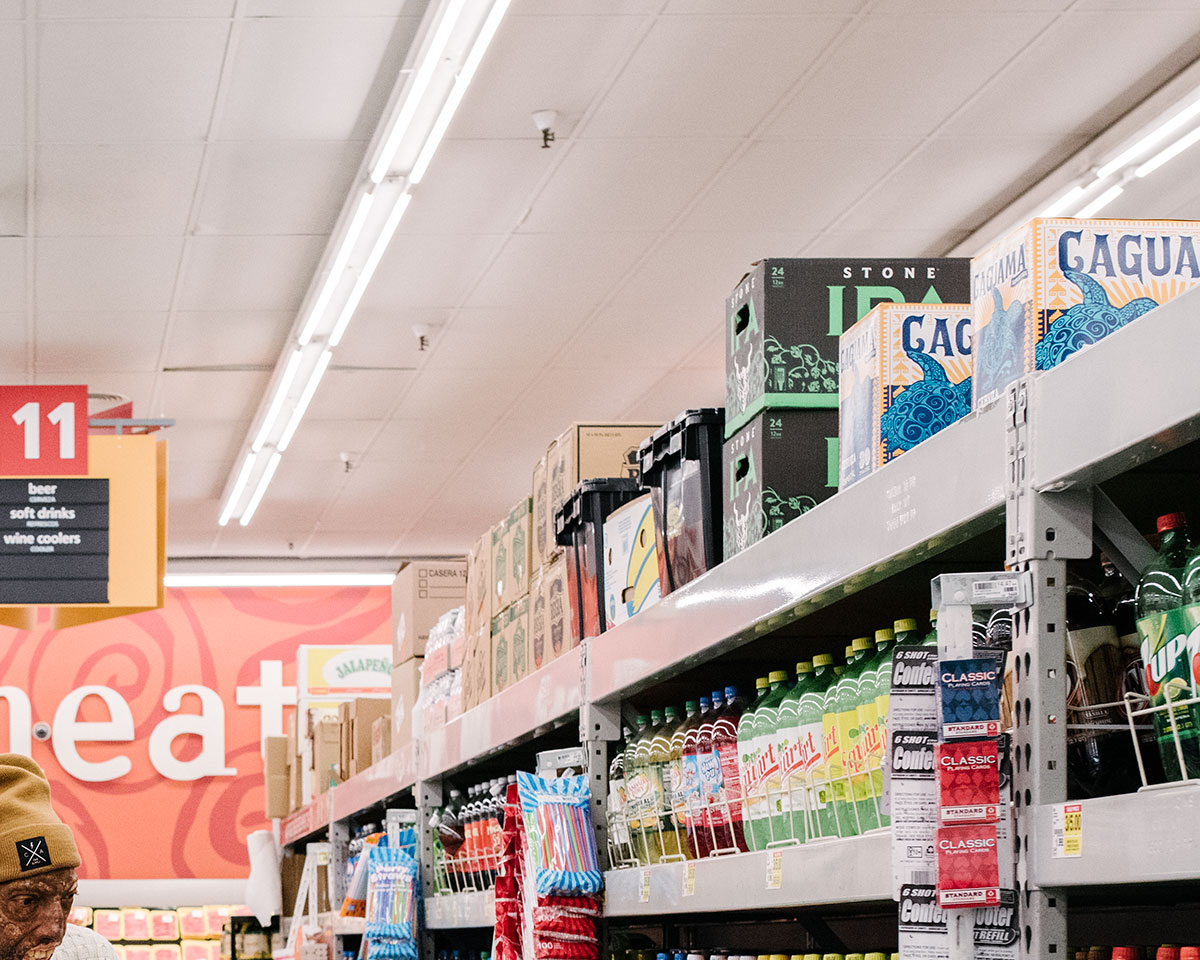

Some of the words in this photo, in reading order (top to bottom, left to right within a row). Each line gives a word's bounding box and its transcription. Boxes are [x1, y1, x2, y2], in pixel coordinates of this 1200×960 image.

[1058, 229, 1200, 285] CAGUA
[771, 267, 784, 277] 24
[843, 267, 937, 280] STONE
[730, 277, 757, 310] STONE
[770, 419, 782, 428] 24
[12, 402, 75, 459] 11
[730, 430, 757, 455] STONE
[28, 482, 57, 495] beer
[10, 507, 35, 520] soft
[37, 507, 76, 520] drinks
[3, 532, 35, 546] wine
[36, 532, 81, 546] coolers
[905, 651, 929, 660] SHOT
[941, 670, 996, 684] CLASSIC
[947, 723, 985, 733] STANDARD
[904, 735, 929, 744] SHOT
[893, 745, 936, 771] Confe
[941, 755, 996, 767] CLASSIC
[946, 807, 984, 817] STANDARD
[939, 838, 995, 851] CLASSIC
[945, 890, 983, 899] STANDARD
[537, 943, 553, 951] 100
